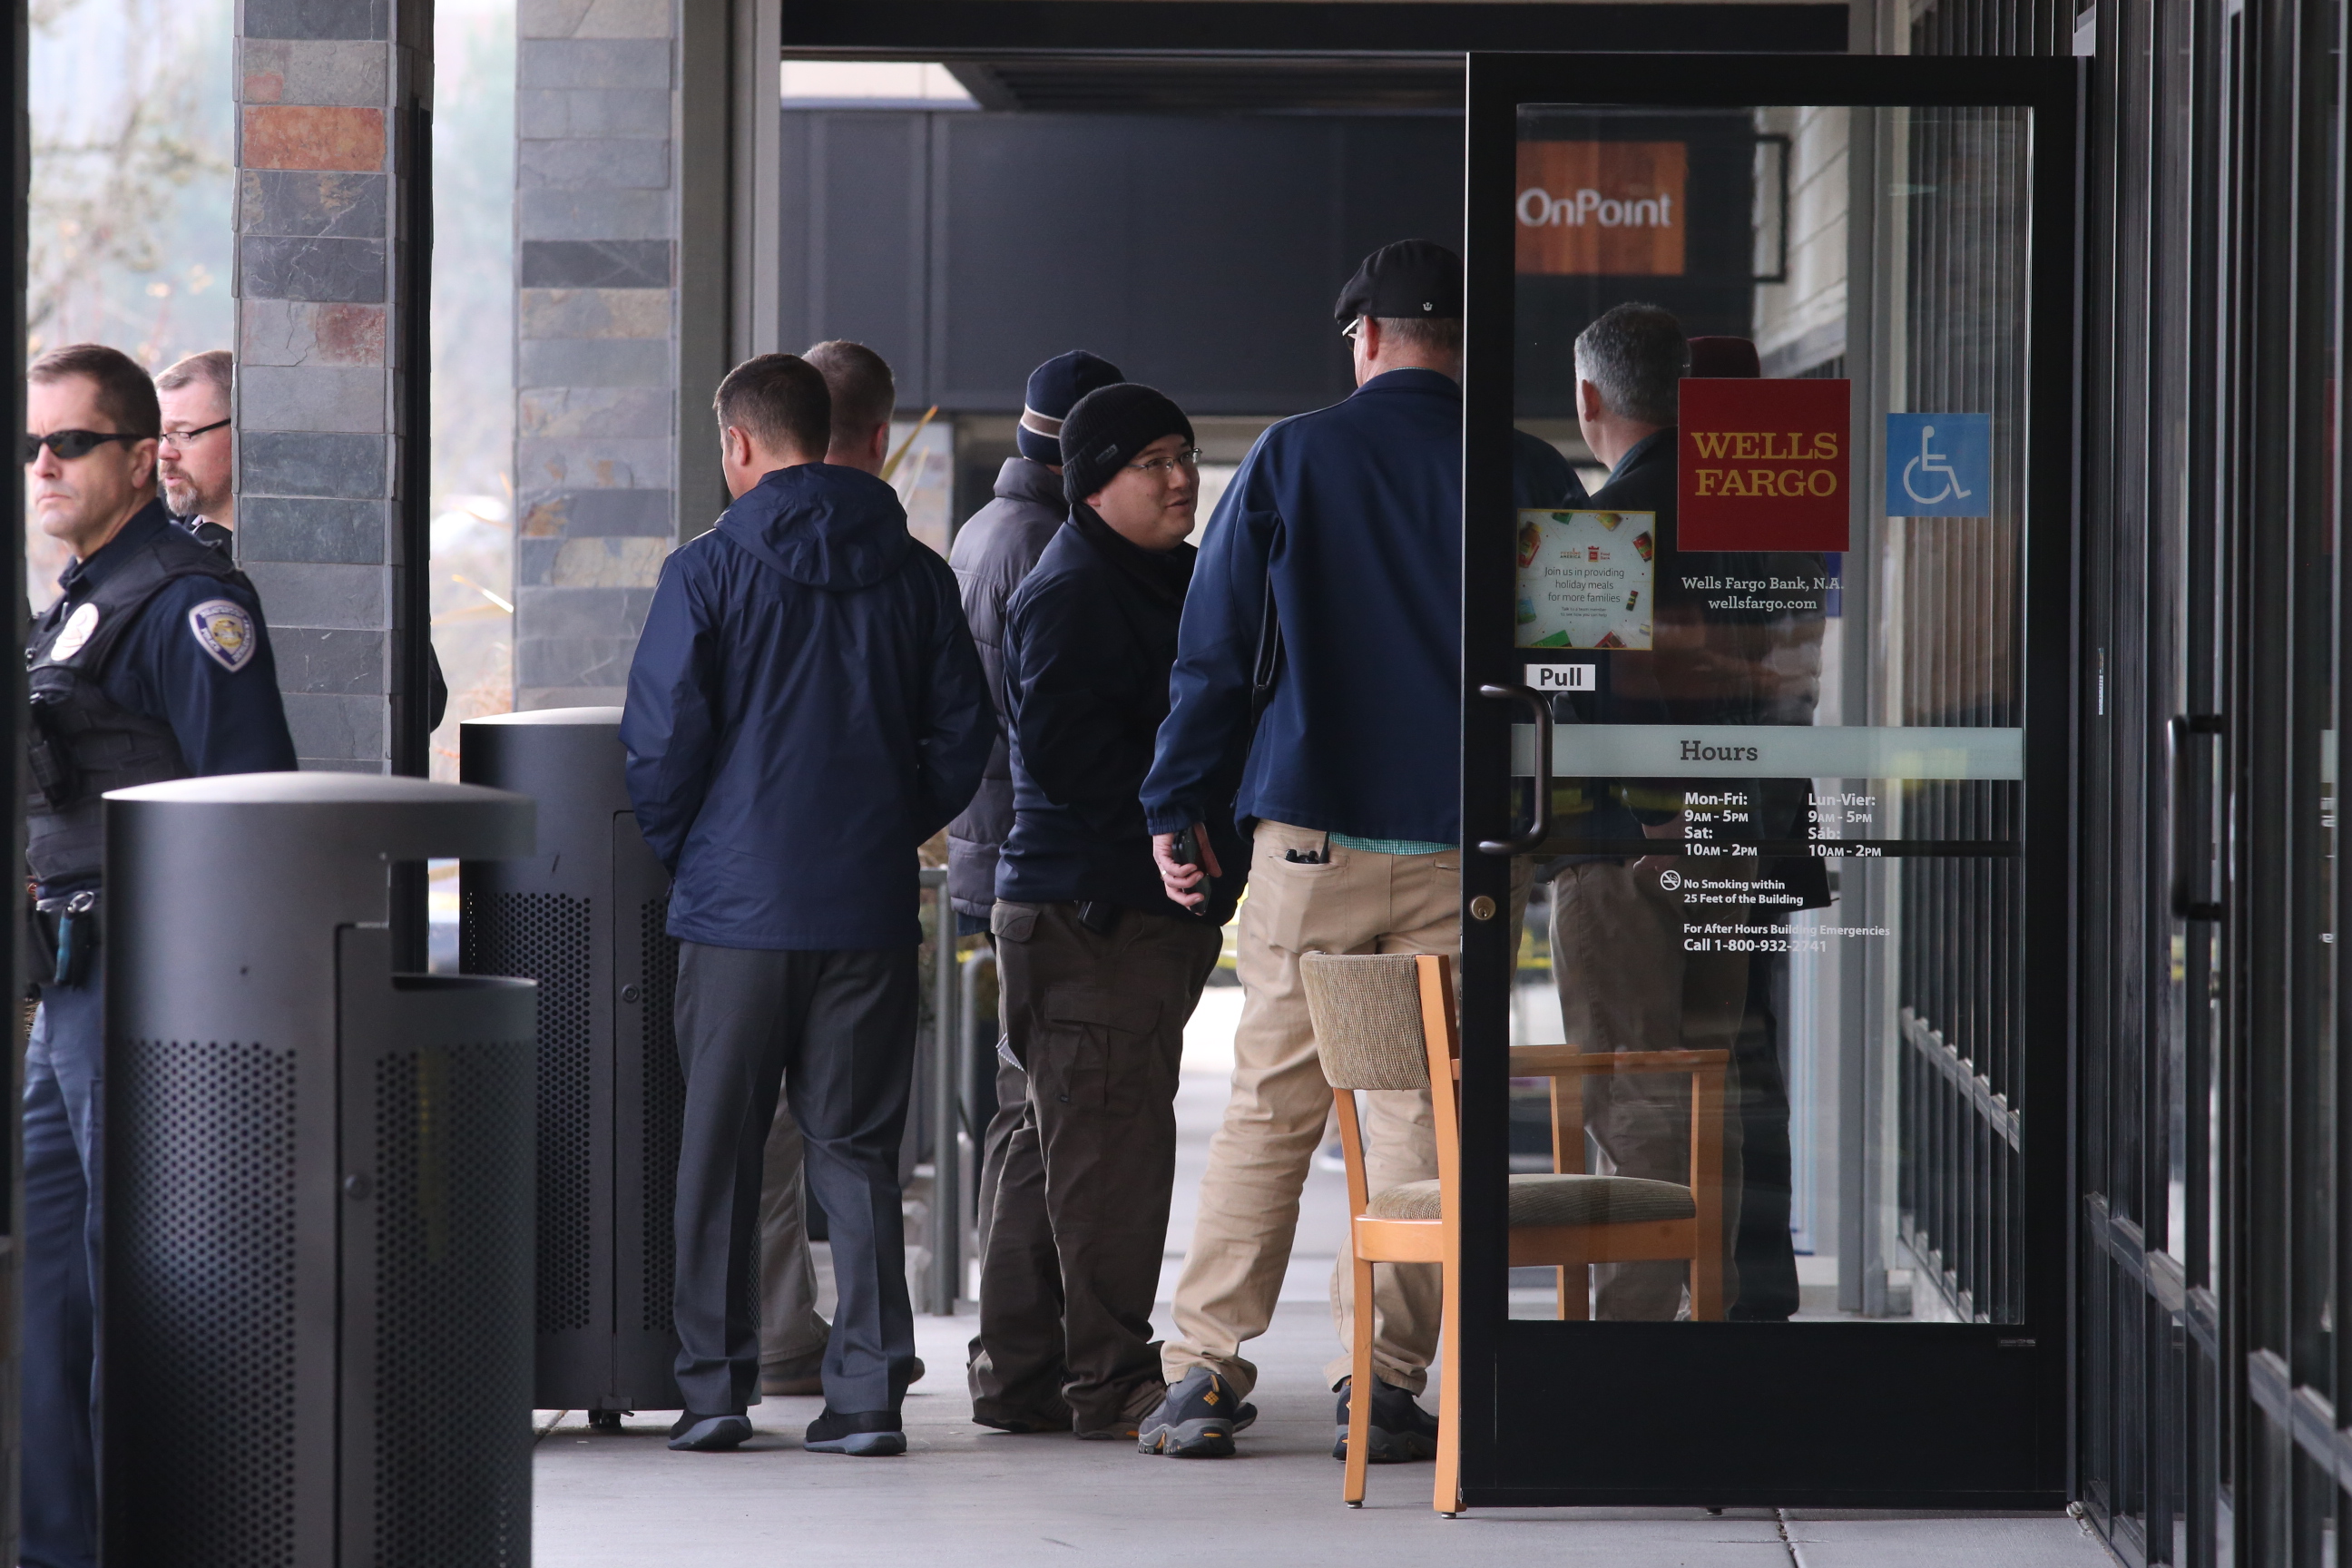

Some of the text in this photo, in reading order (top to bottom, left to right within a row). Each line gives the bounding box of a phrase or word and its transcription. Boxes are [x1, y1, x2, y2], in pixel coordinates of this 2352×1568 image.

[1517, 187, 1672, 228] OnPoint
[1691, 432, 1838, 459] WELLS
[1695, 469, 1837, 496] FARGO
[1544, 567, 1561, 577] Join
[1575, 568, 1583, 576] in
[1584, 568, 1624, 579] providing
[1555, 580, 1613, 591] holiday meals
[1681, 576, 1844, 593] Wells Fargo Bank, N.A.
[1548, 593, 1560, 602] for
[1587, 593, 1621, 603] families
[1708, 595, 1817, 612] wellsfargo.com
[1540, 668, 1582, 686] Pull
[1681, 740, 1758, 760] Hours
[1685, 792, 1748, 806] Mon-Fri:
[1808, 793, 1876, 806] Lun-Vier:
[1685, 810, 1711, 822] 9AM
[1723, 809, 1749, 822] 5PM
[1808, 810, 1835, 822] 9AM
[1847, 811, 1872, 823] 5PM
[1684, 827, 1712, 839] Sat:
[1808, 828, 1840, 839] Sáb:
[1685, 844, 1720, 856] 10AM
[1732, 844, 1757, 856] 2PM
[1808, 845, 1844, 857] 10AM
[1856, 845, 1881, 857] 2PM
[1684, 879, 1785, 891] No Smoking within
[1684, 894, 1803, 906] 25 Feet of the Building
[1684, 924, 1889, 937] For After Hours Building Emergencies
[1684, 939, 1827, 952] Call 1-800-932-2741
